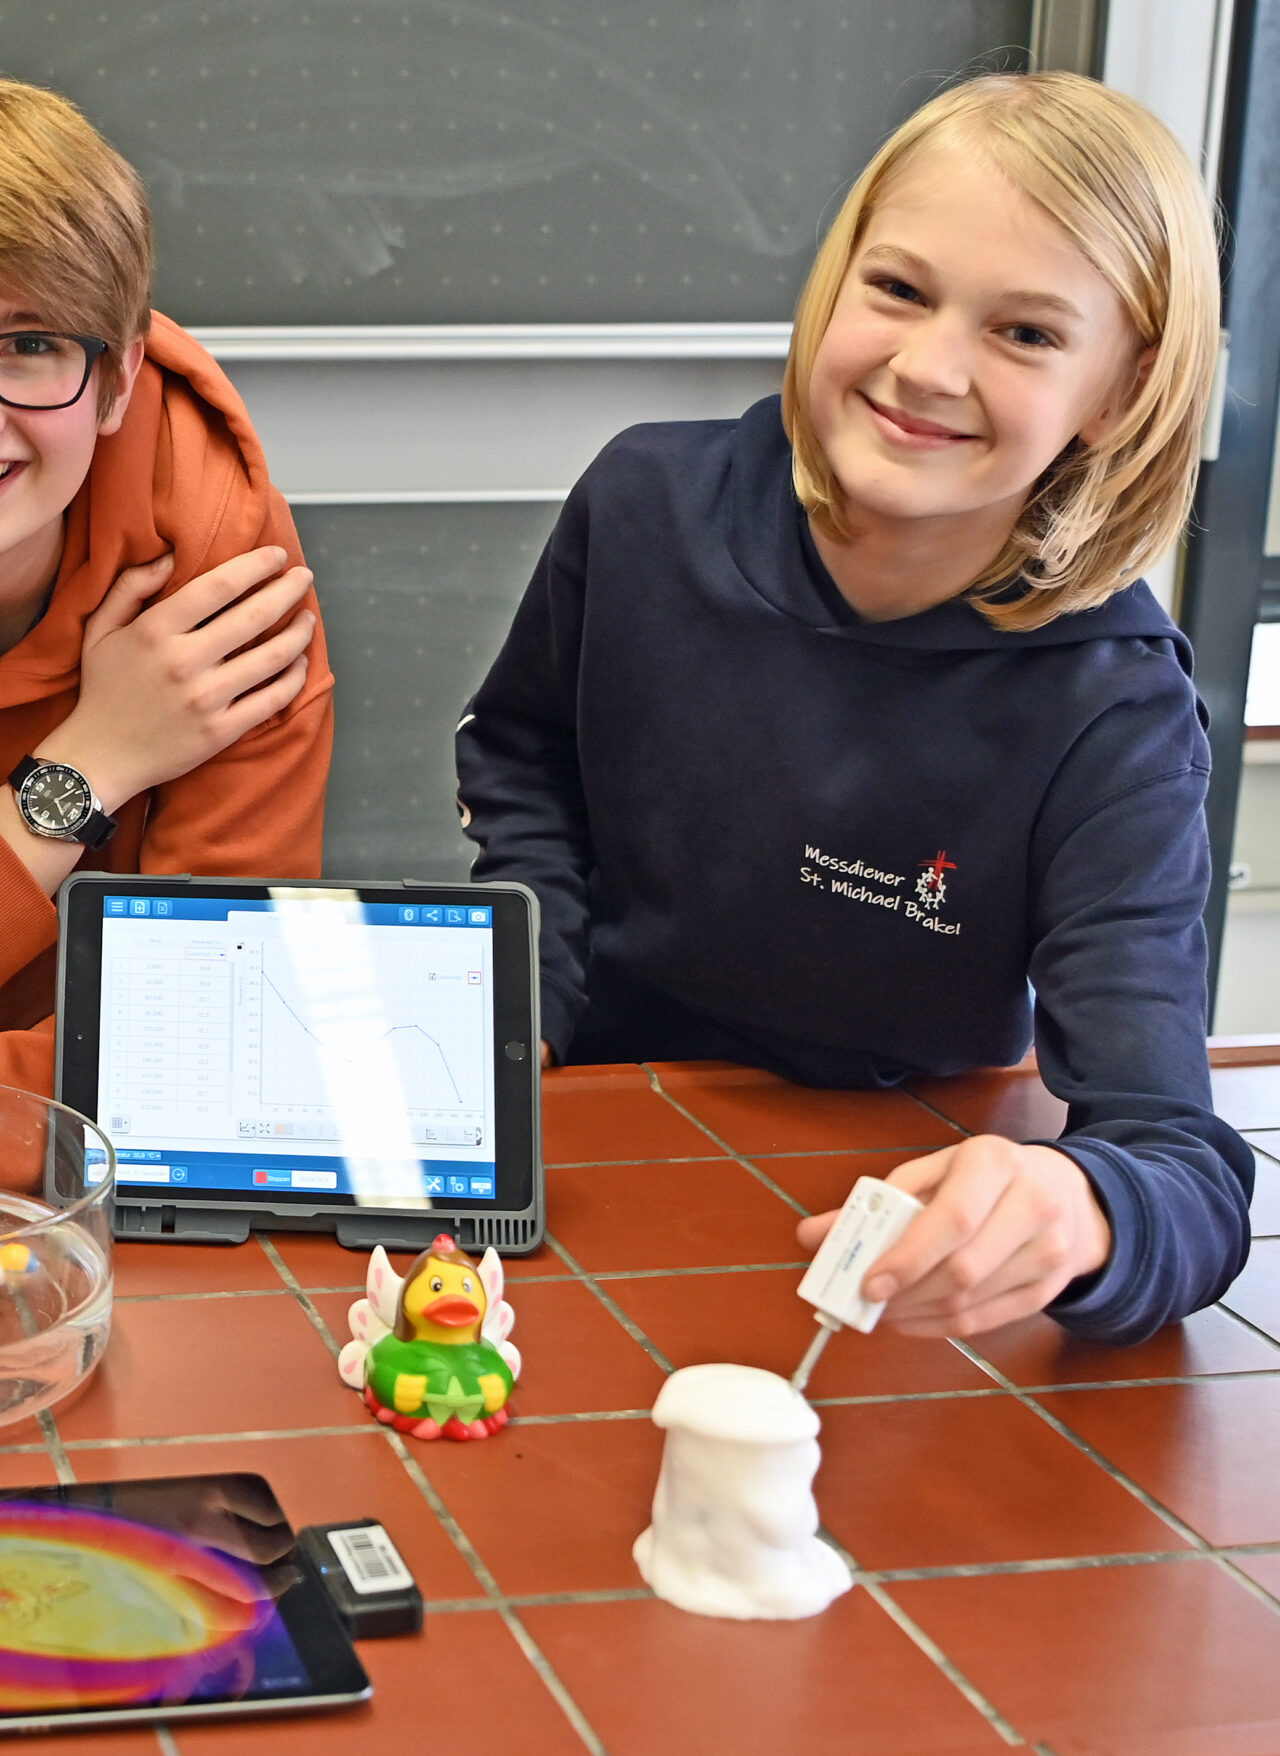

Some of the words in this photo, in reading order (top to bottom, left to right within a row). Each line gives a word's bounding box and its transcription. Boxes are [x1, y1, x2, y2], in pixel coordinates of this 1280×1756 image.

[804, 844, 906, 887] Messdiener
[800, 866, 824, 890] St.
[831, 879, 901, 911] Michael
[904, 900, 961, 935] Brakel
